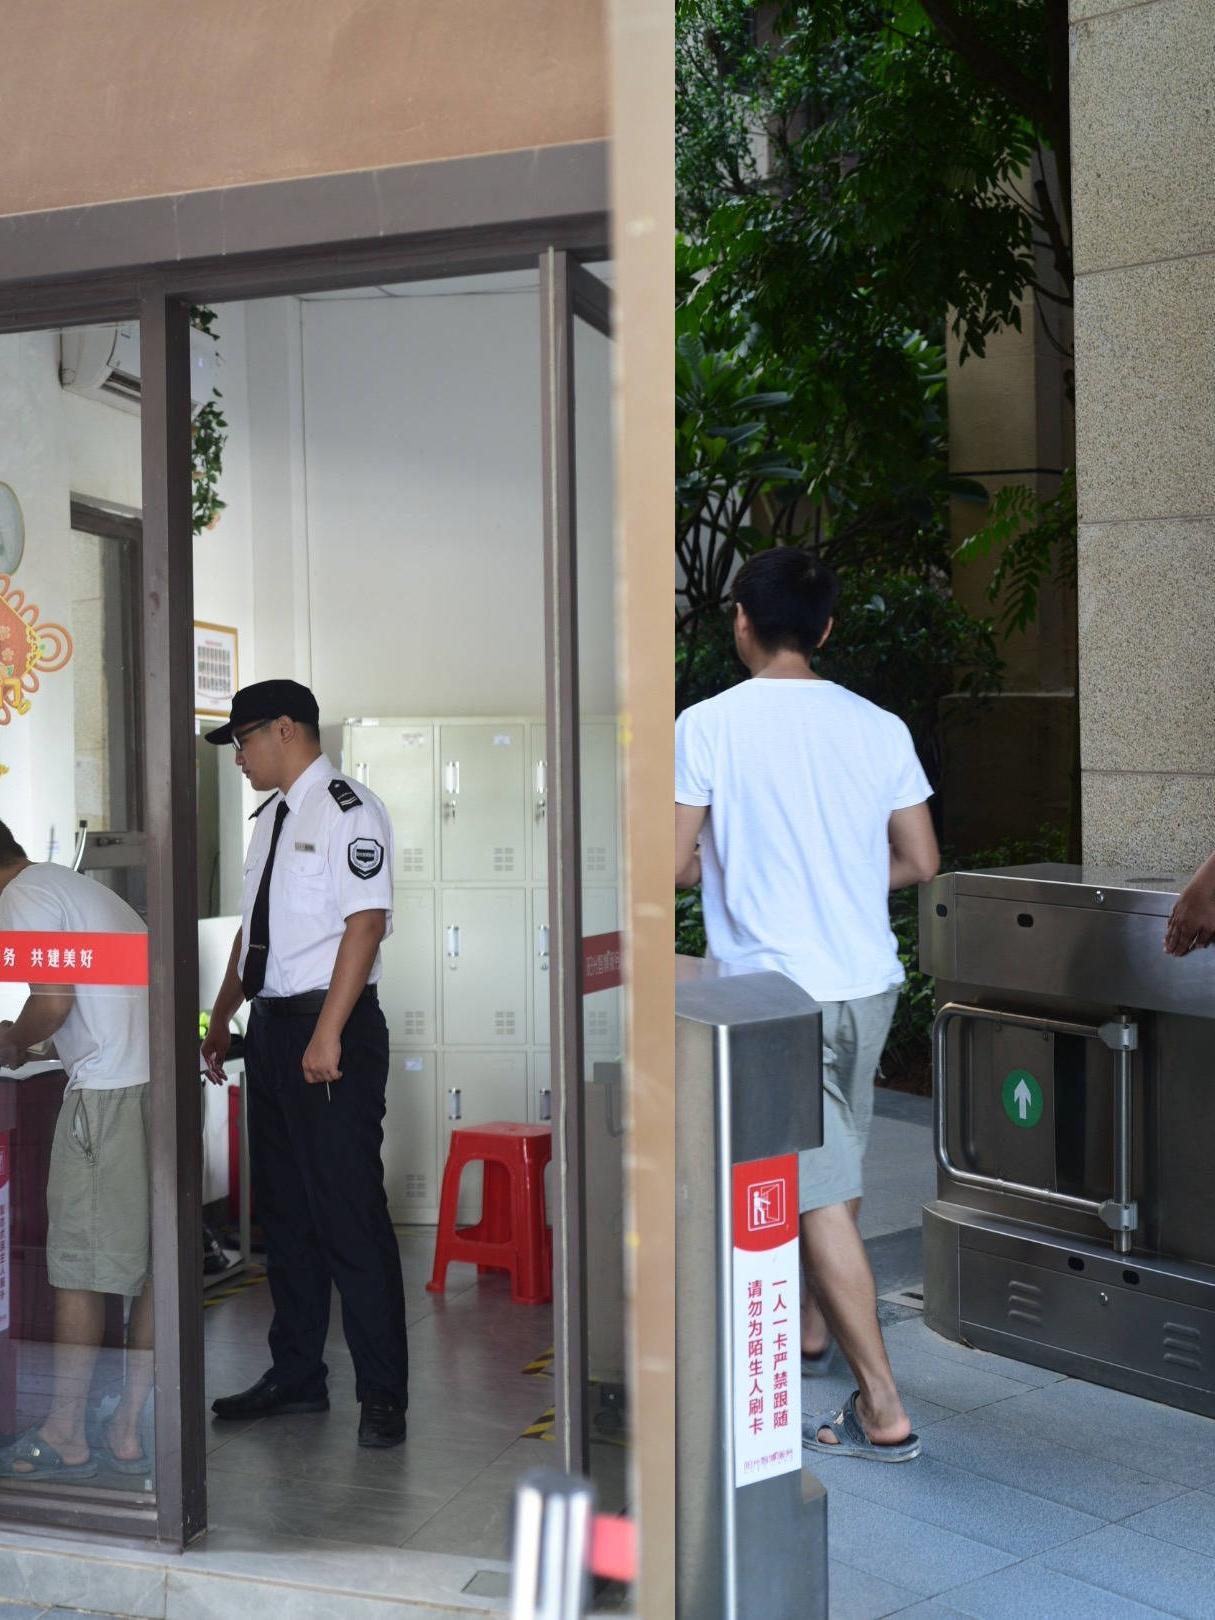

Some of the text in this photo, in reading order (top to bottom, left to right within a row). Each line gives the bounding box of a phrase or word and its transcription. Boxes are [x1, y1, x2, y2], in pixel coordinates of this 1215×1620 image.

[31, 948, 94, 969] 共建美好
[748, 1280, 763, 1435] 请勿为陌生人刷卡
[773, 1279, 788, 1428] 一人一卡严禁跟随
